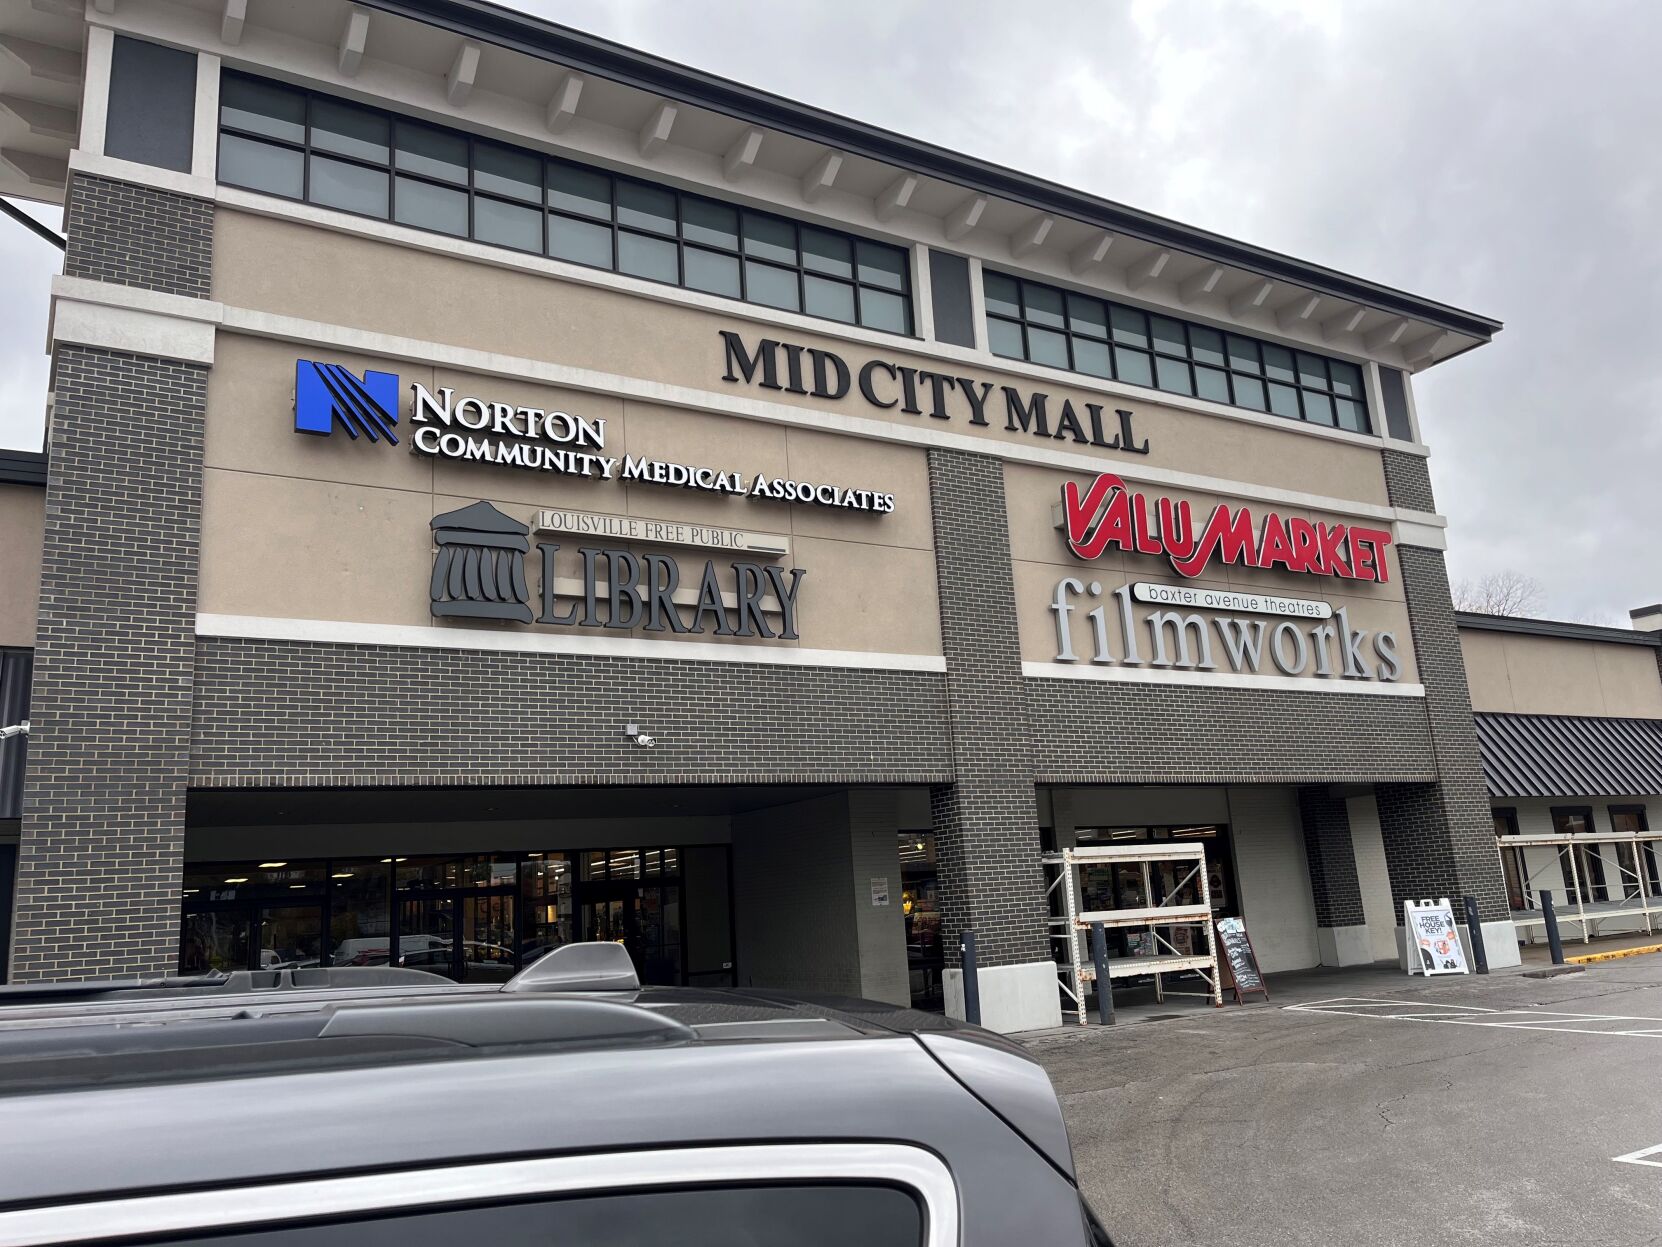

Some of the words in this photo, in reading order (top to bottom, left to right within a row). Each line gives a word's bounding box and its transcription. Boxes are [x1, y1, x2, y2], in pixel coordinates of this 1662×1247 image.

[411, 382, 606, 450] NORTON
[719, 330, 851, 400] MID
[858, 359, 995, 426] CITY
[1001, 385, 1149, 455] MALL
[411, 426, 616, 480] COMMUNITY
[620, 456, 748, 495] MEDICAL
[752, 474, 895, 514] ASSOCIATES
[540, 511, 638, 536] LOUISVILLE
[645, 522, 685, 542] FREE
[691, 528, 744, 548] PUBLIC
[1062, 473, 1194, 560] VALU
[1170, 503, 1392, 583] MARKET
[536, 543, 806, 640] LIBRARY
[1051, 577, 1402, 681] filmworks
[1149, 586, 1197, 603] baxter
[1204, 594, 1258, 610] avenue
[1265, 598, 1321, 616] theatres
[1419, 921, 1446, 929] HOUSE
